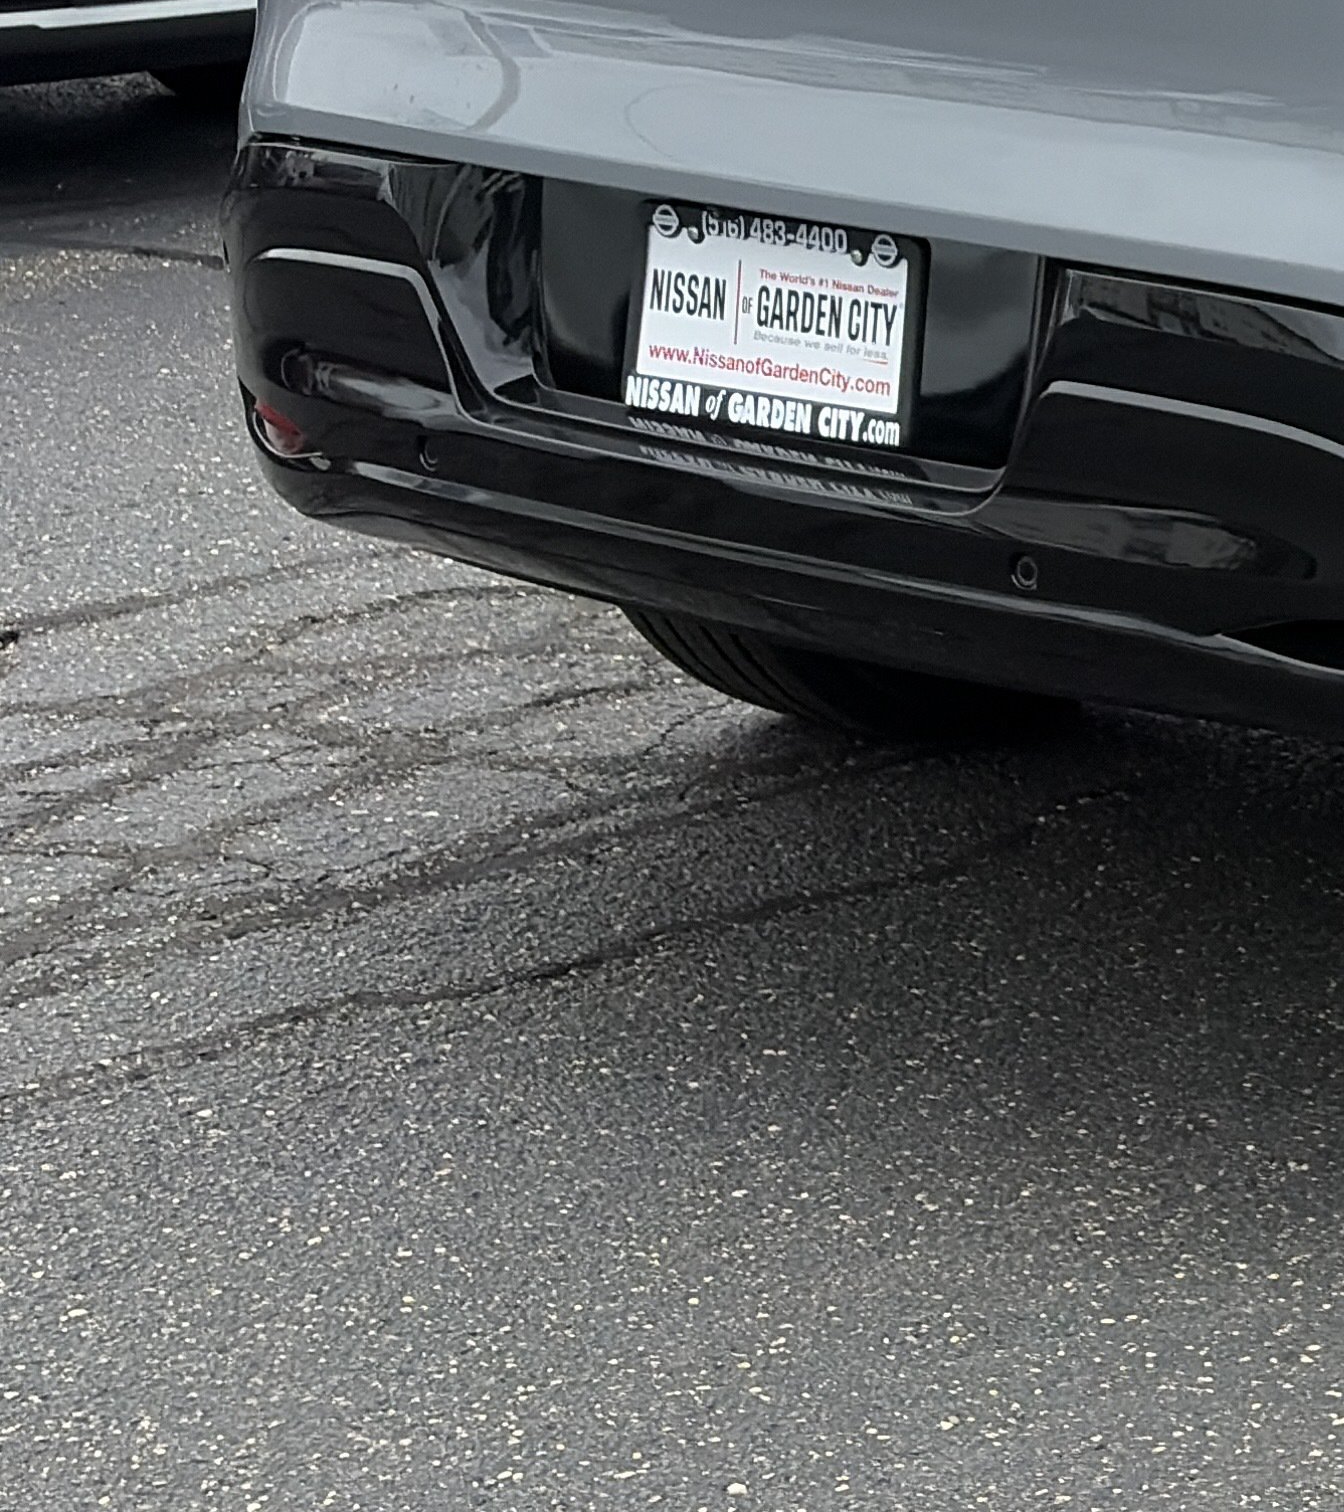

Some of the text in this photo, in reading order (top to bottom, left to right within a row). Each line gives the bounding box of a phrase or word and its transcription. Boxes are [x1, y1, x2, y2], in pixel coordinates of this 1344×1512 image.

[750, 217, 848, 254] 483-4400
[650, 268, 897, 347] NISSAN OF GARDEN CITY
[759, 268, 899, 298] The World's #1 Nissan Dealer
[648, 344, 892, 397] www.NissanofGardenCity.com
[625, 375, 701, 417] NISSAN
[705, 390, 727, 421] of
[728, 392, 812, 434] GARDEN
[817, 406, 901, 446] CITY.com
